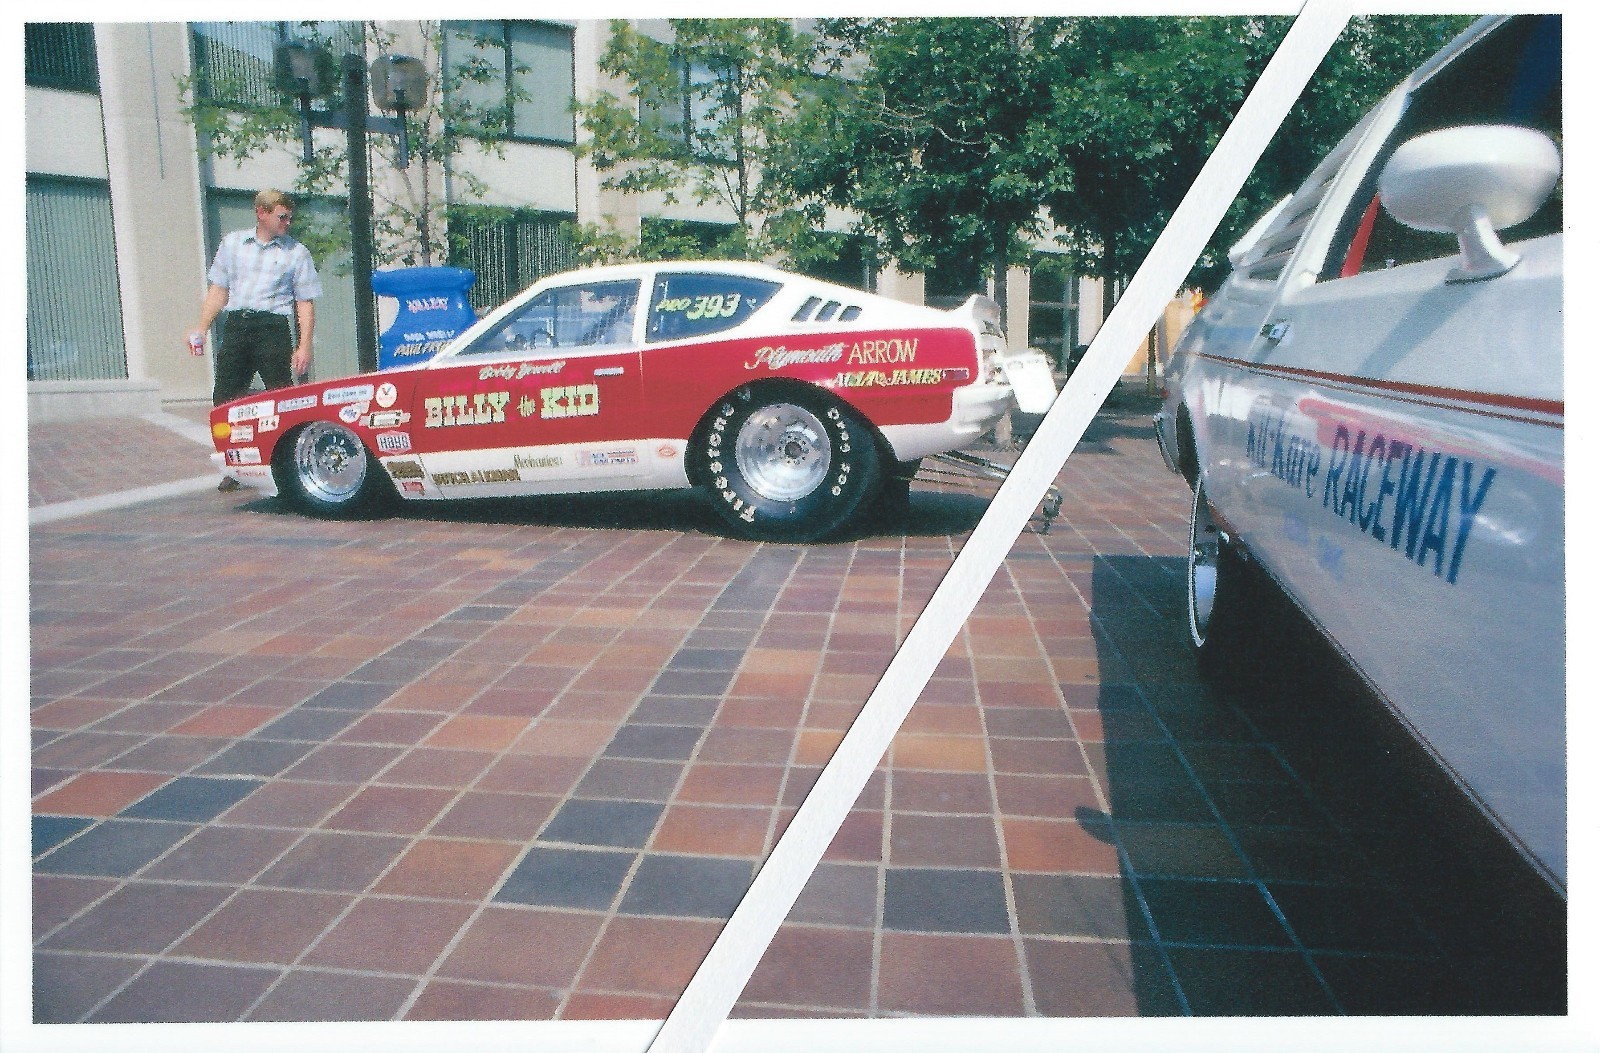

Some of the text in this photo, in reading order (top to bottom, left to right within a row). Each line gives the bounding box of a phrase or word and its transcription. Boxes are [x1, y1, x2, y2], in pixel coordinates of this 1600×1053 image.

[686, 293, 741, 320] 393
[744, 338, 919, 370] Plymouth ARROW
[424, 391, 510, 428] BILLY
[517, 395, 536, 417] the
[540, 384, 599, 419] KID
[1322, 424, 1497, 585] RACEWAY
